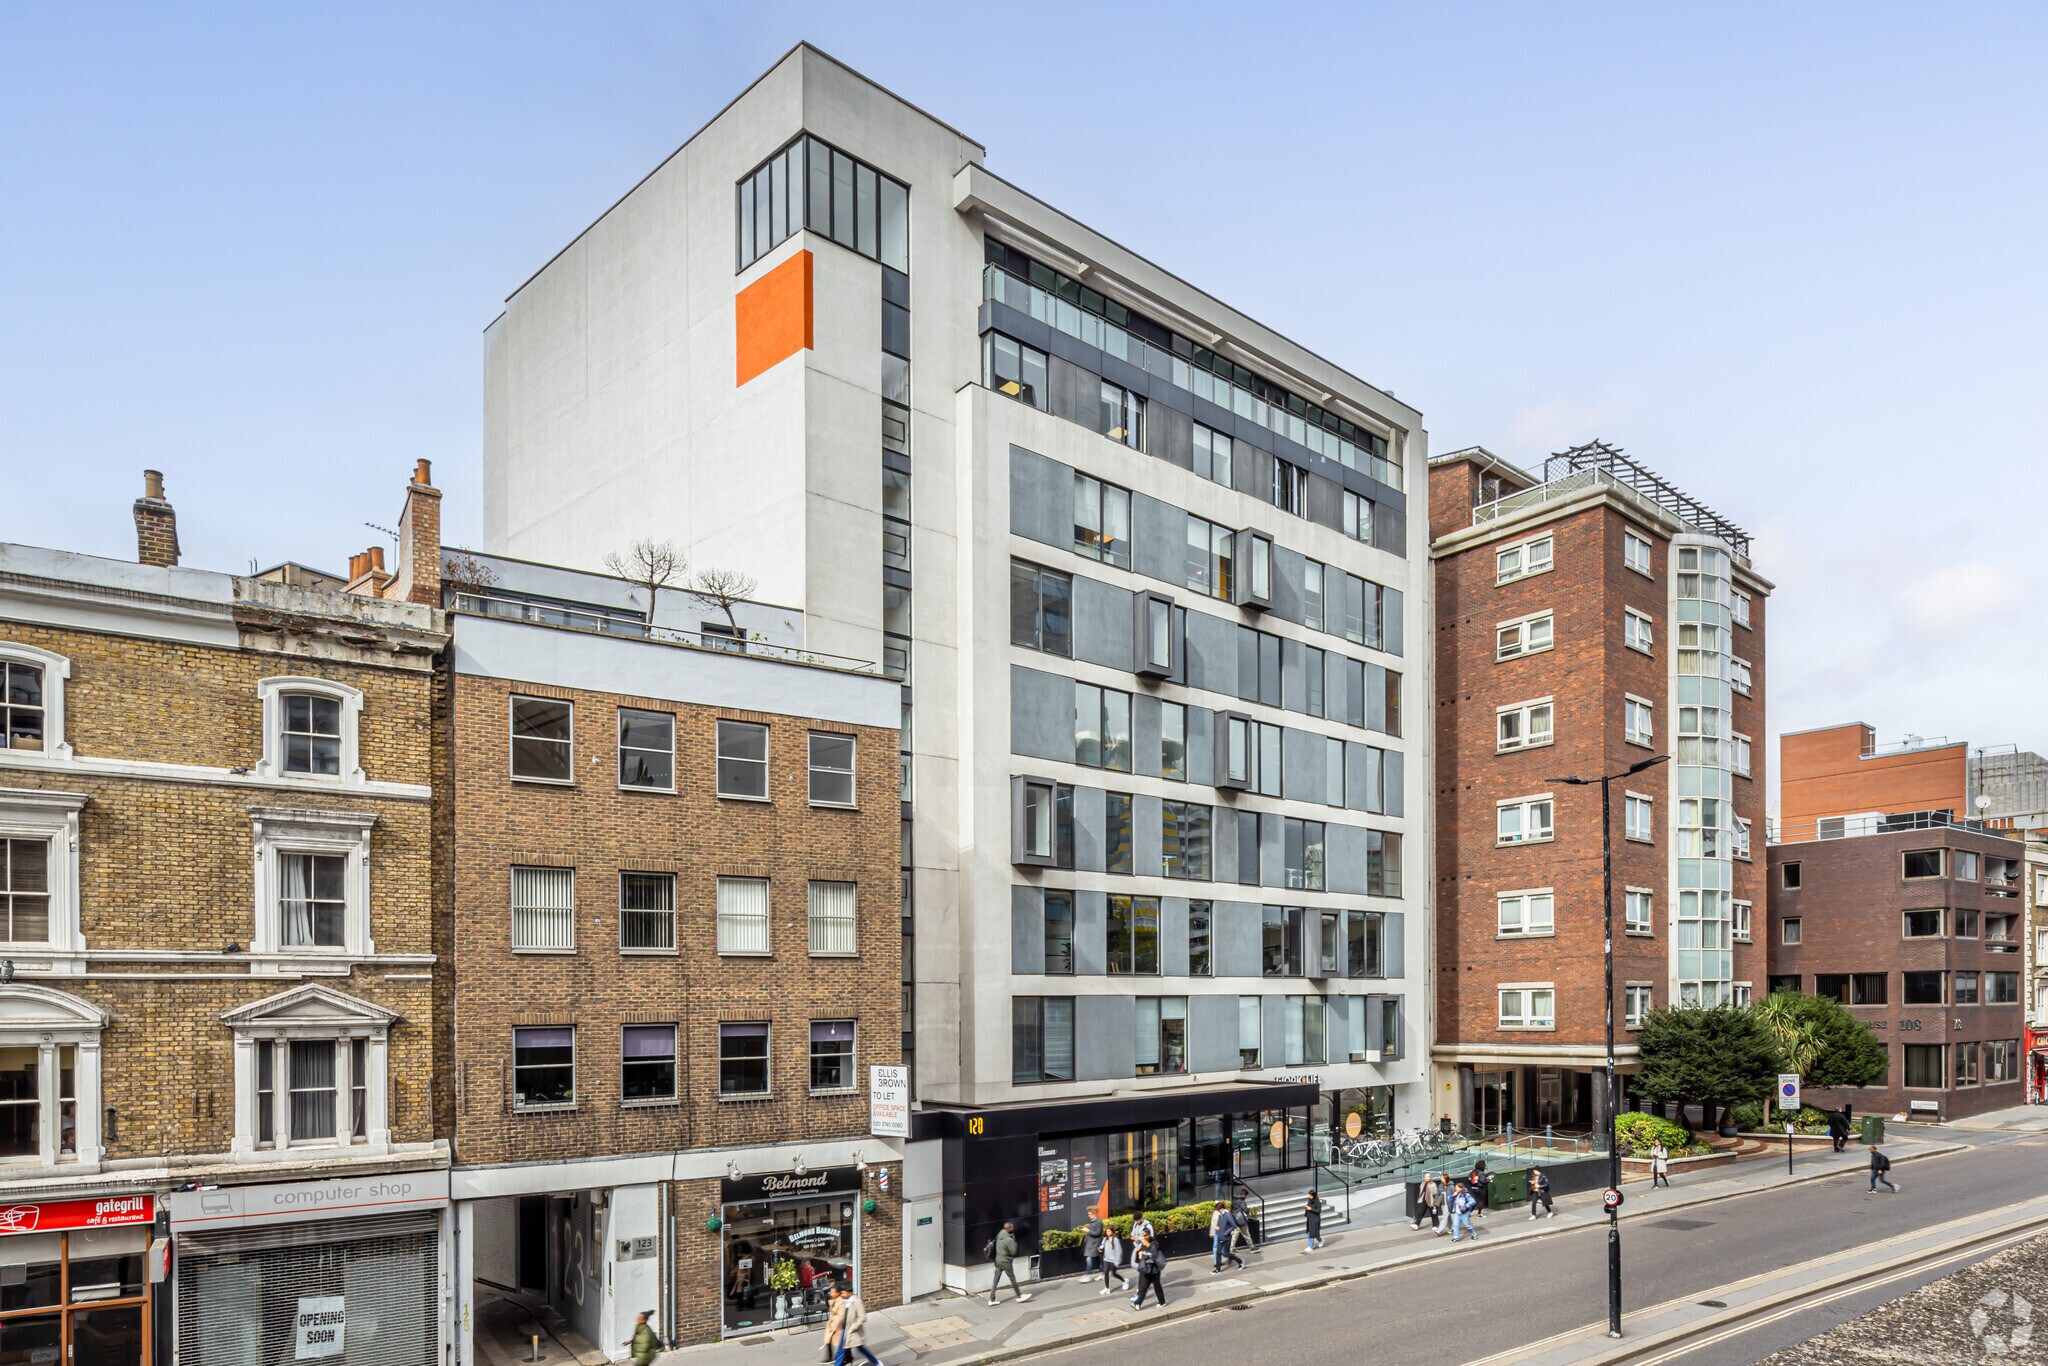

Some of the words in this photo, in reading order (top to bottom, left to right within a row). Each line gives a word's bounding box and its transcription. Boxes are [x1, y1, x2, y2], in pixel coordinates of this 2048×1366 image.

[878, 1068, 898, 1078] ELLIS
[878, 1078, 906, 1088] BROWN
[872, 1091, 882, 1100] TO
[883, 1092, 895, 1101] LET
[873, 1103, 889, 1111] OFFICE
[969, 1117, 984, 1134] 120
[762, 1172, 828, 1191] Belmond
[273, 1187, 362, 1205] computer
[369, 1182, 412, 1197] shop
[1605, 1193, 1617, 1202] 20
[95, 1197, 144, 1216] gategrill
[108, 1214, 144, 1223] restaurant
[637, 1238, 652, 1248] 123
[299, 1310, 345, 1328] OPENING
[306, 1329, 336, 1344] SOON
